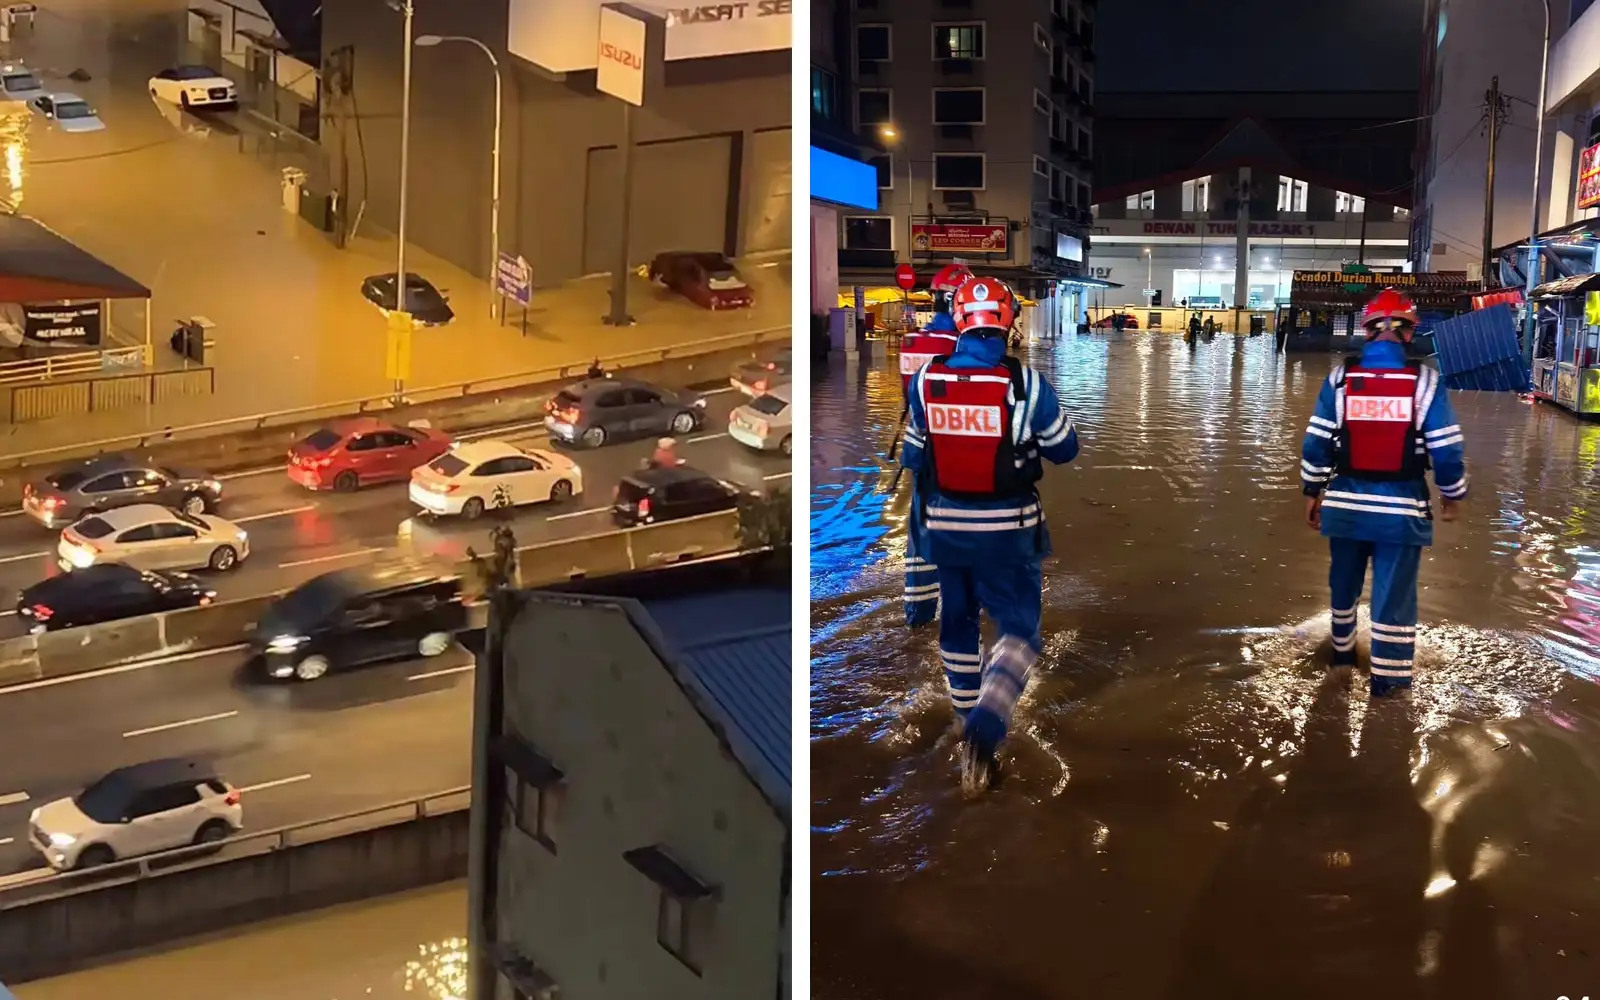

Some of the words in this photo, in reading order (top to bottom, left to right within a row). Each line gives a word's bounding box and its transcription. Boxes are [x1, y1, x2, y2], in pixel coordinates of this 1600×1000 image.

[600, 42, 641, 70] ISUZU
[1143, 222, 1195, 234] DEWAN
[1207, 223, 1238, 235] TUN
[1306, 225, 1314, 235] 1
[1294, 271, 1331, 282] Cendol
[1334, 271, 1372, 284] Durian
[1375, 272, 1416, 285] Runtuh
[1351, 399, 1408, 419] DBKL
[930, 406, 998, 433] DBKL
